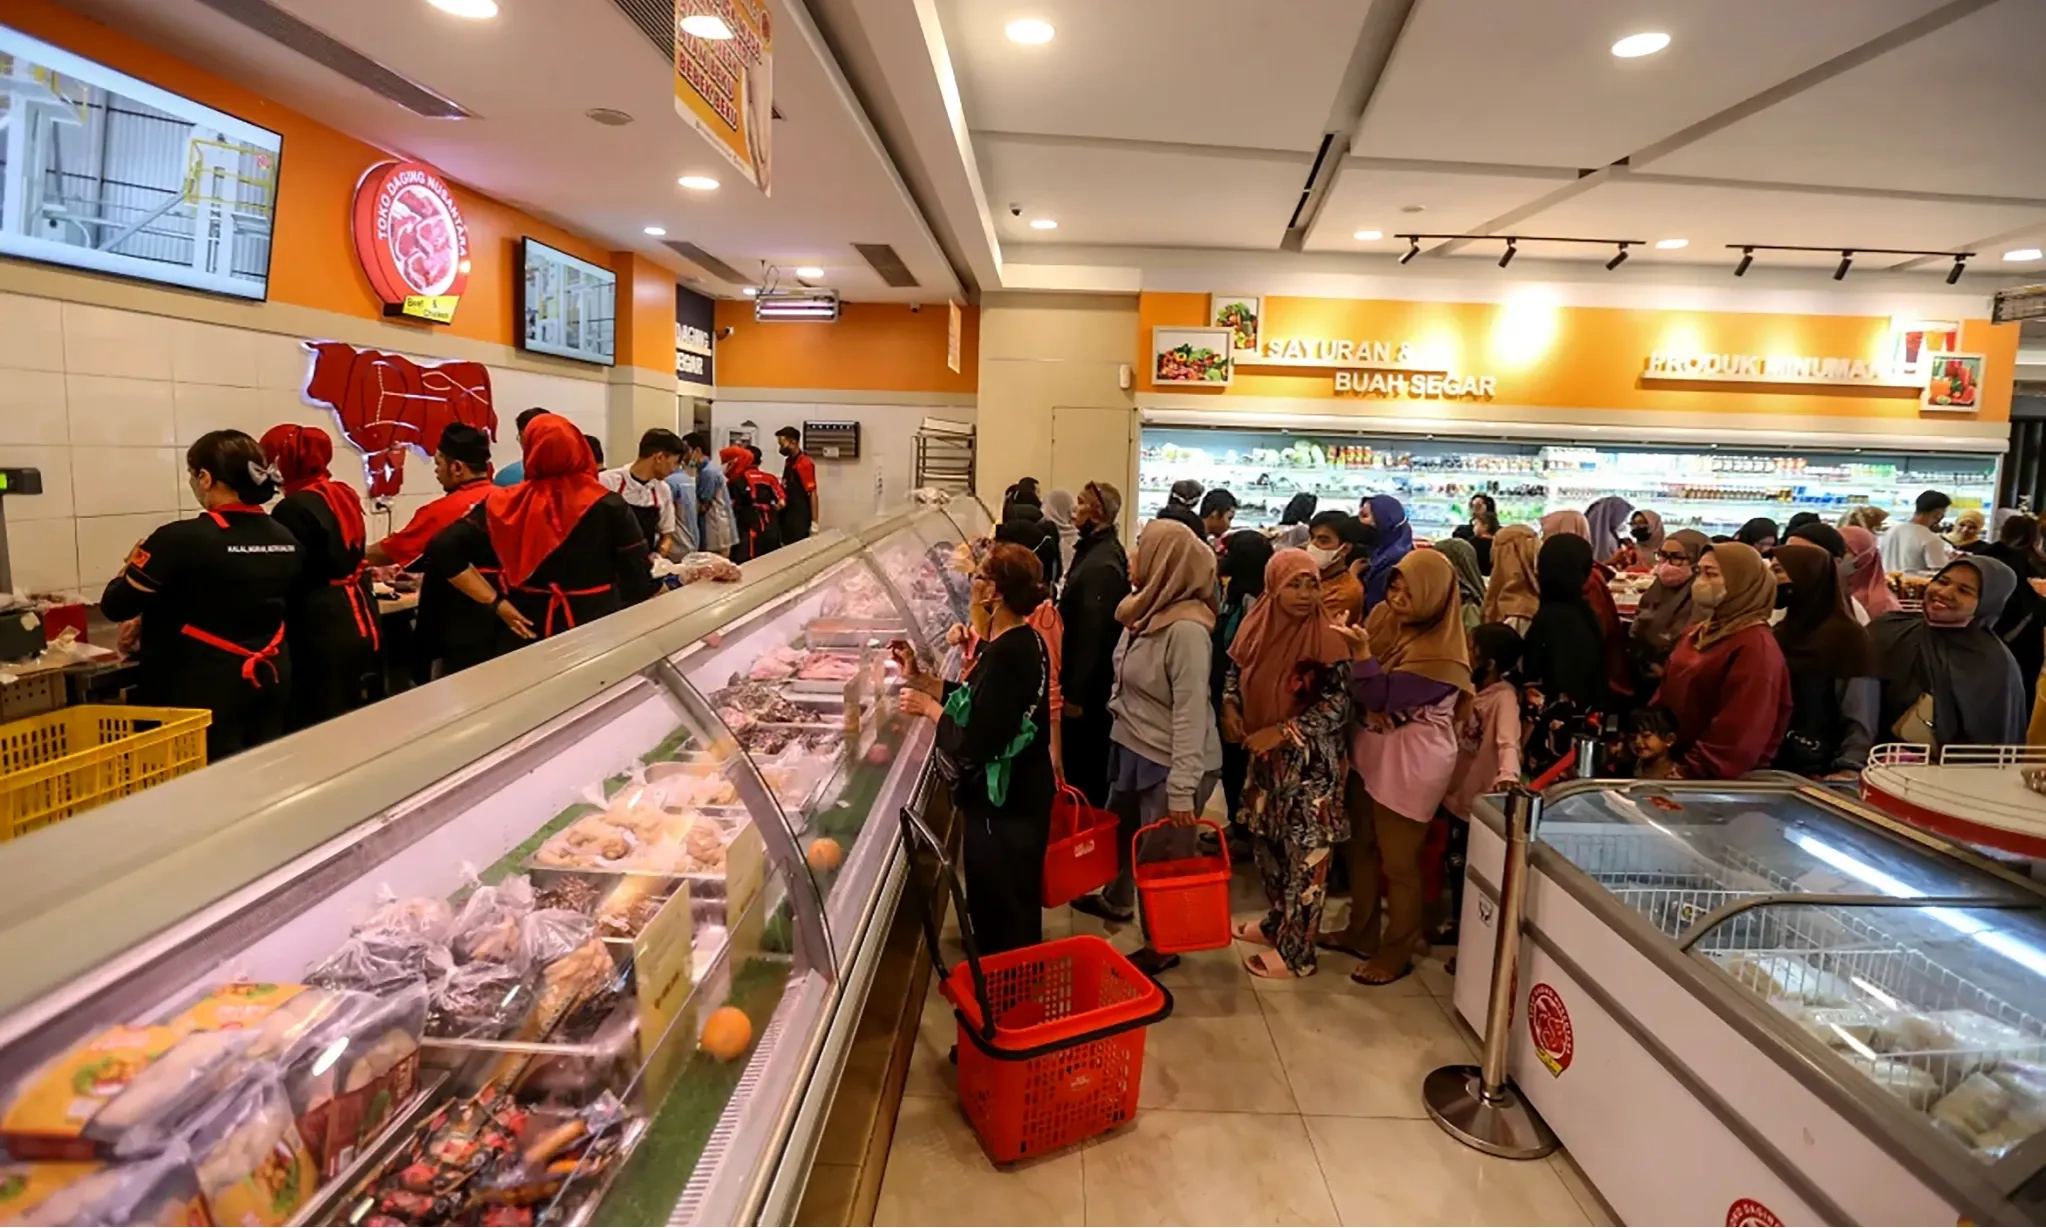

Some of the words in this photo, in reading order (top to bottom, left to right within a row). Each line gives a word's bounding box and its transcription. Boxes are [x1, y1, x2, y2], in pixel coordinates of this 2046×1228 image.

[377, 194, 391, 241] TOKO
[386, 170, 426, 194] DAGING
[427, 175, 468, 257] NUSANTARA
[1266, 339, 1392, 363] SAYURAN
[1396, 343, 1415, 363] &
[1647, 352, 1758, 376] PRODUK
[1335, 371, 1406, 394] BUAH
[1410, 373, 1497, 397] SEGAR
